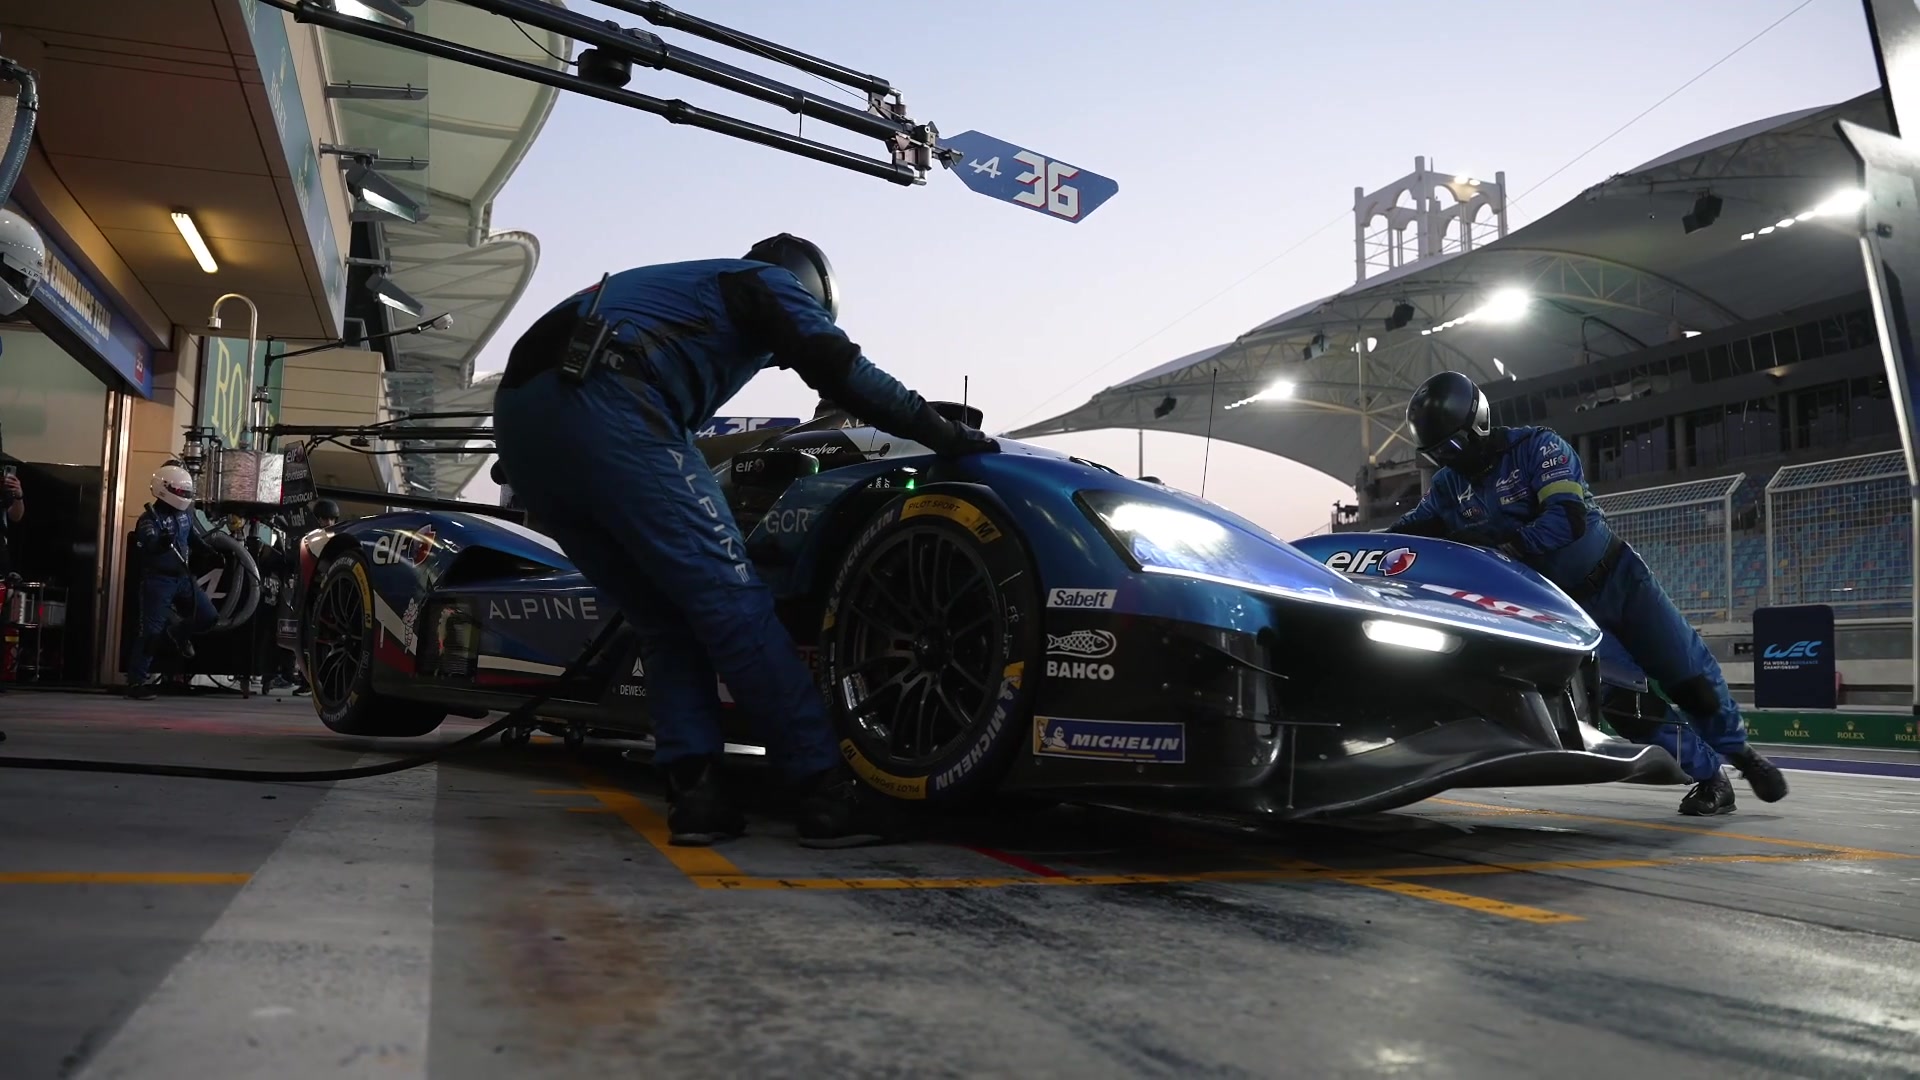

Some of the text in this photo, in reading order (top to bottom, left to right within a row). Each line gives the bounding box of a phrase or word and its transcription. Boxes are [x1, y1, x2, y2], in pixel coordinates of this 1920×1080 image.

[1012, 149, 1080, 220] 36
[286, 450, 298, 464] elf
[735, 460, 753, 473] elf
[1541, 457, 1558, 470] elf
[667, 448, 750, 584] ALPINE
[908, 500, 992, 538] PILOT SPORT M
[372, 532, 411, 566] elf
[834, 509, 894, 593] MICHELIN
[1325, 550, 1382, 573] elf
[1053, 590, 1108, 607] Sabelt
[489, 597, 600, 621] ALPINE
[1763, 640, 1823, 658] WEC
[1046, 661, 1115, 680] BAHCO
[1071, 733, 1180, 751] MICHELIN
[1784, 729, 1810, 737] ROLEX
[1837, 731, 1865, 740] ROLEX
[936, 704, 1006, 791] MICHELIN
